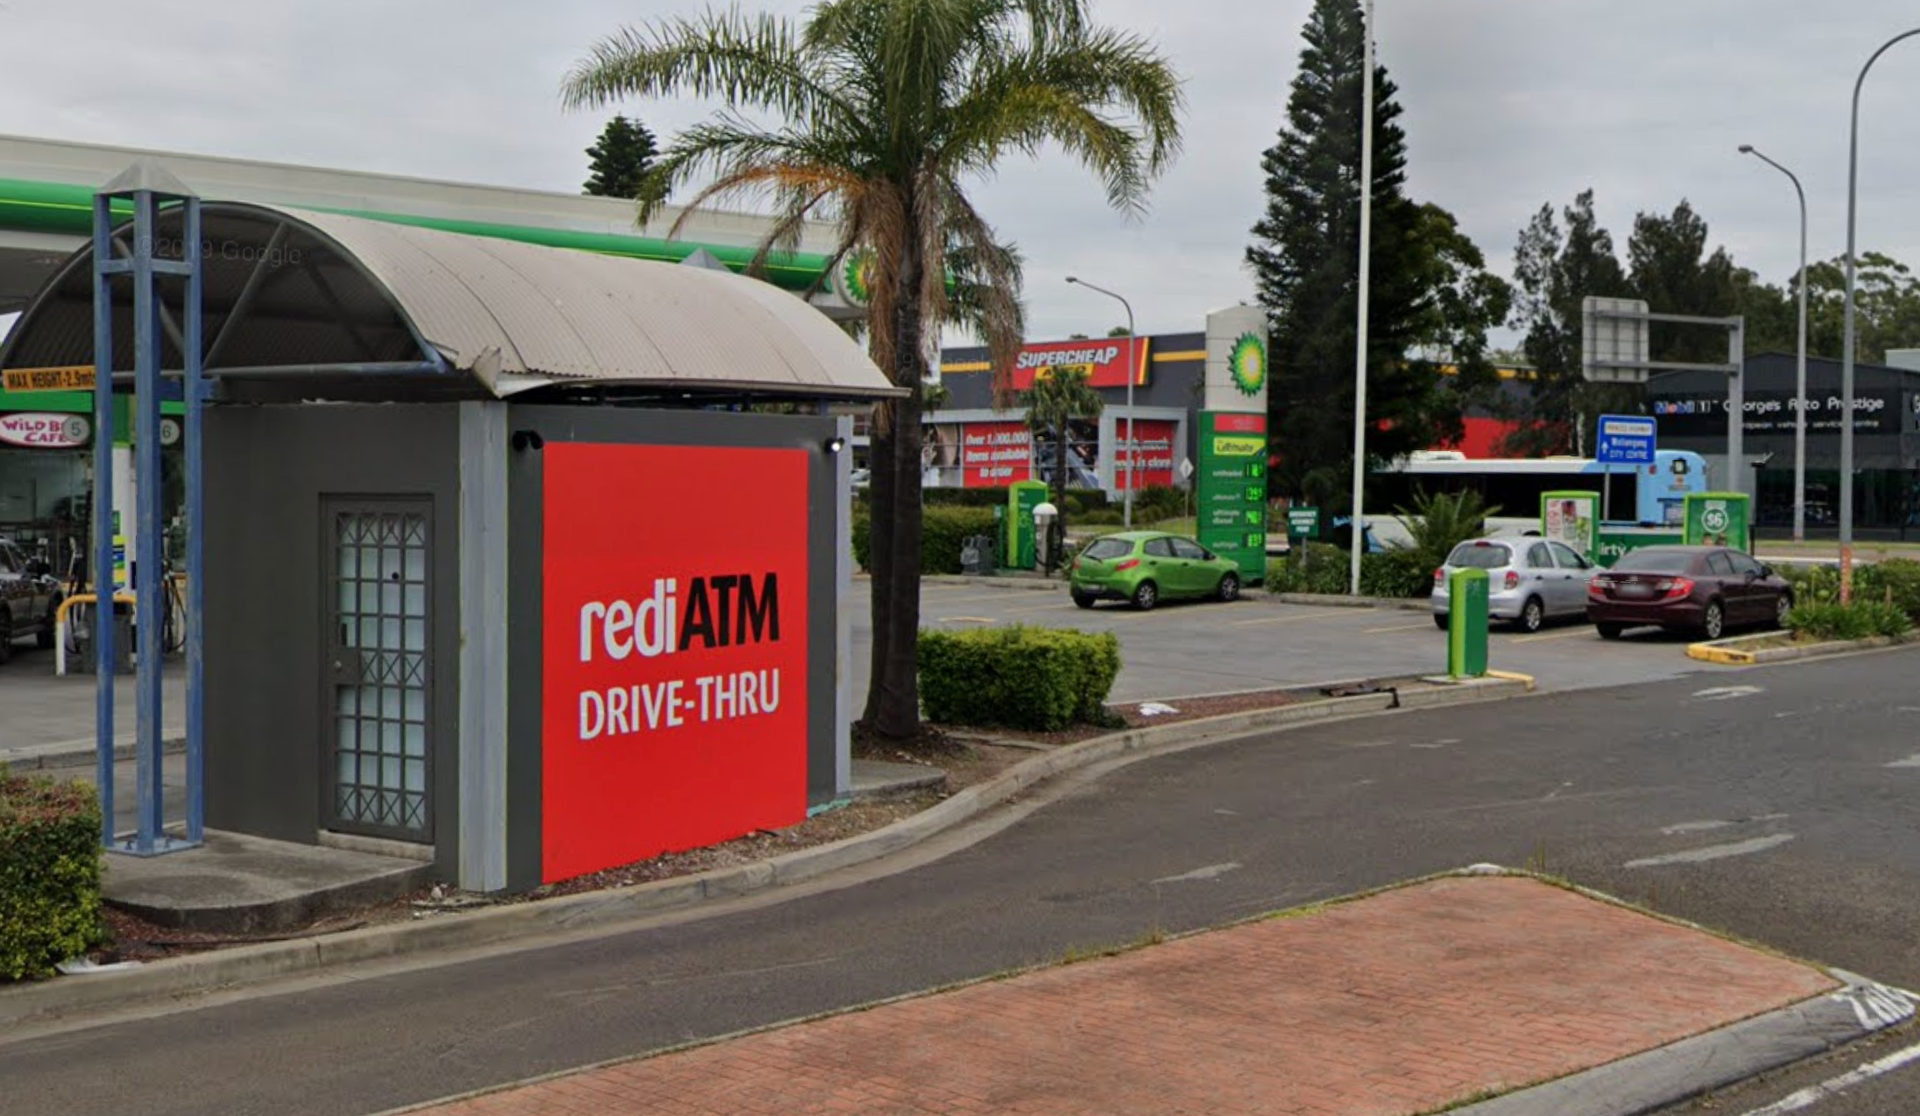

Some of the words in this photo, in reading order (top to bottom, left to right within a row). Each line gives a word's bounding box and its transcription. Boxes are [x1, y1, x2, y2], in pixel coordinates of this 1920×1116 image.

[1016, 346, 1119, 370] SUPERCHEAP
[7, 372, 28, 388] MAX
[1723, 399, 1781, 415] Gorge's
[1787, 398, 1820, 411] Ato
[1827, 396, 1885, 412] Prstige
[71, 421, 81, 436] 5
[162, 424, 171, 438] 6
[580, 572, 779, 662] rediATM
[579, 667, 779, 740] DRIVE-THRU
